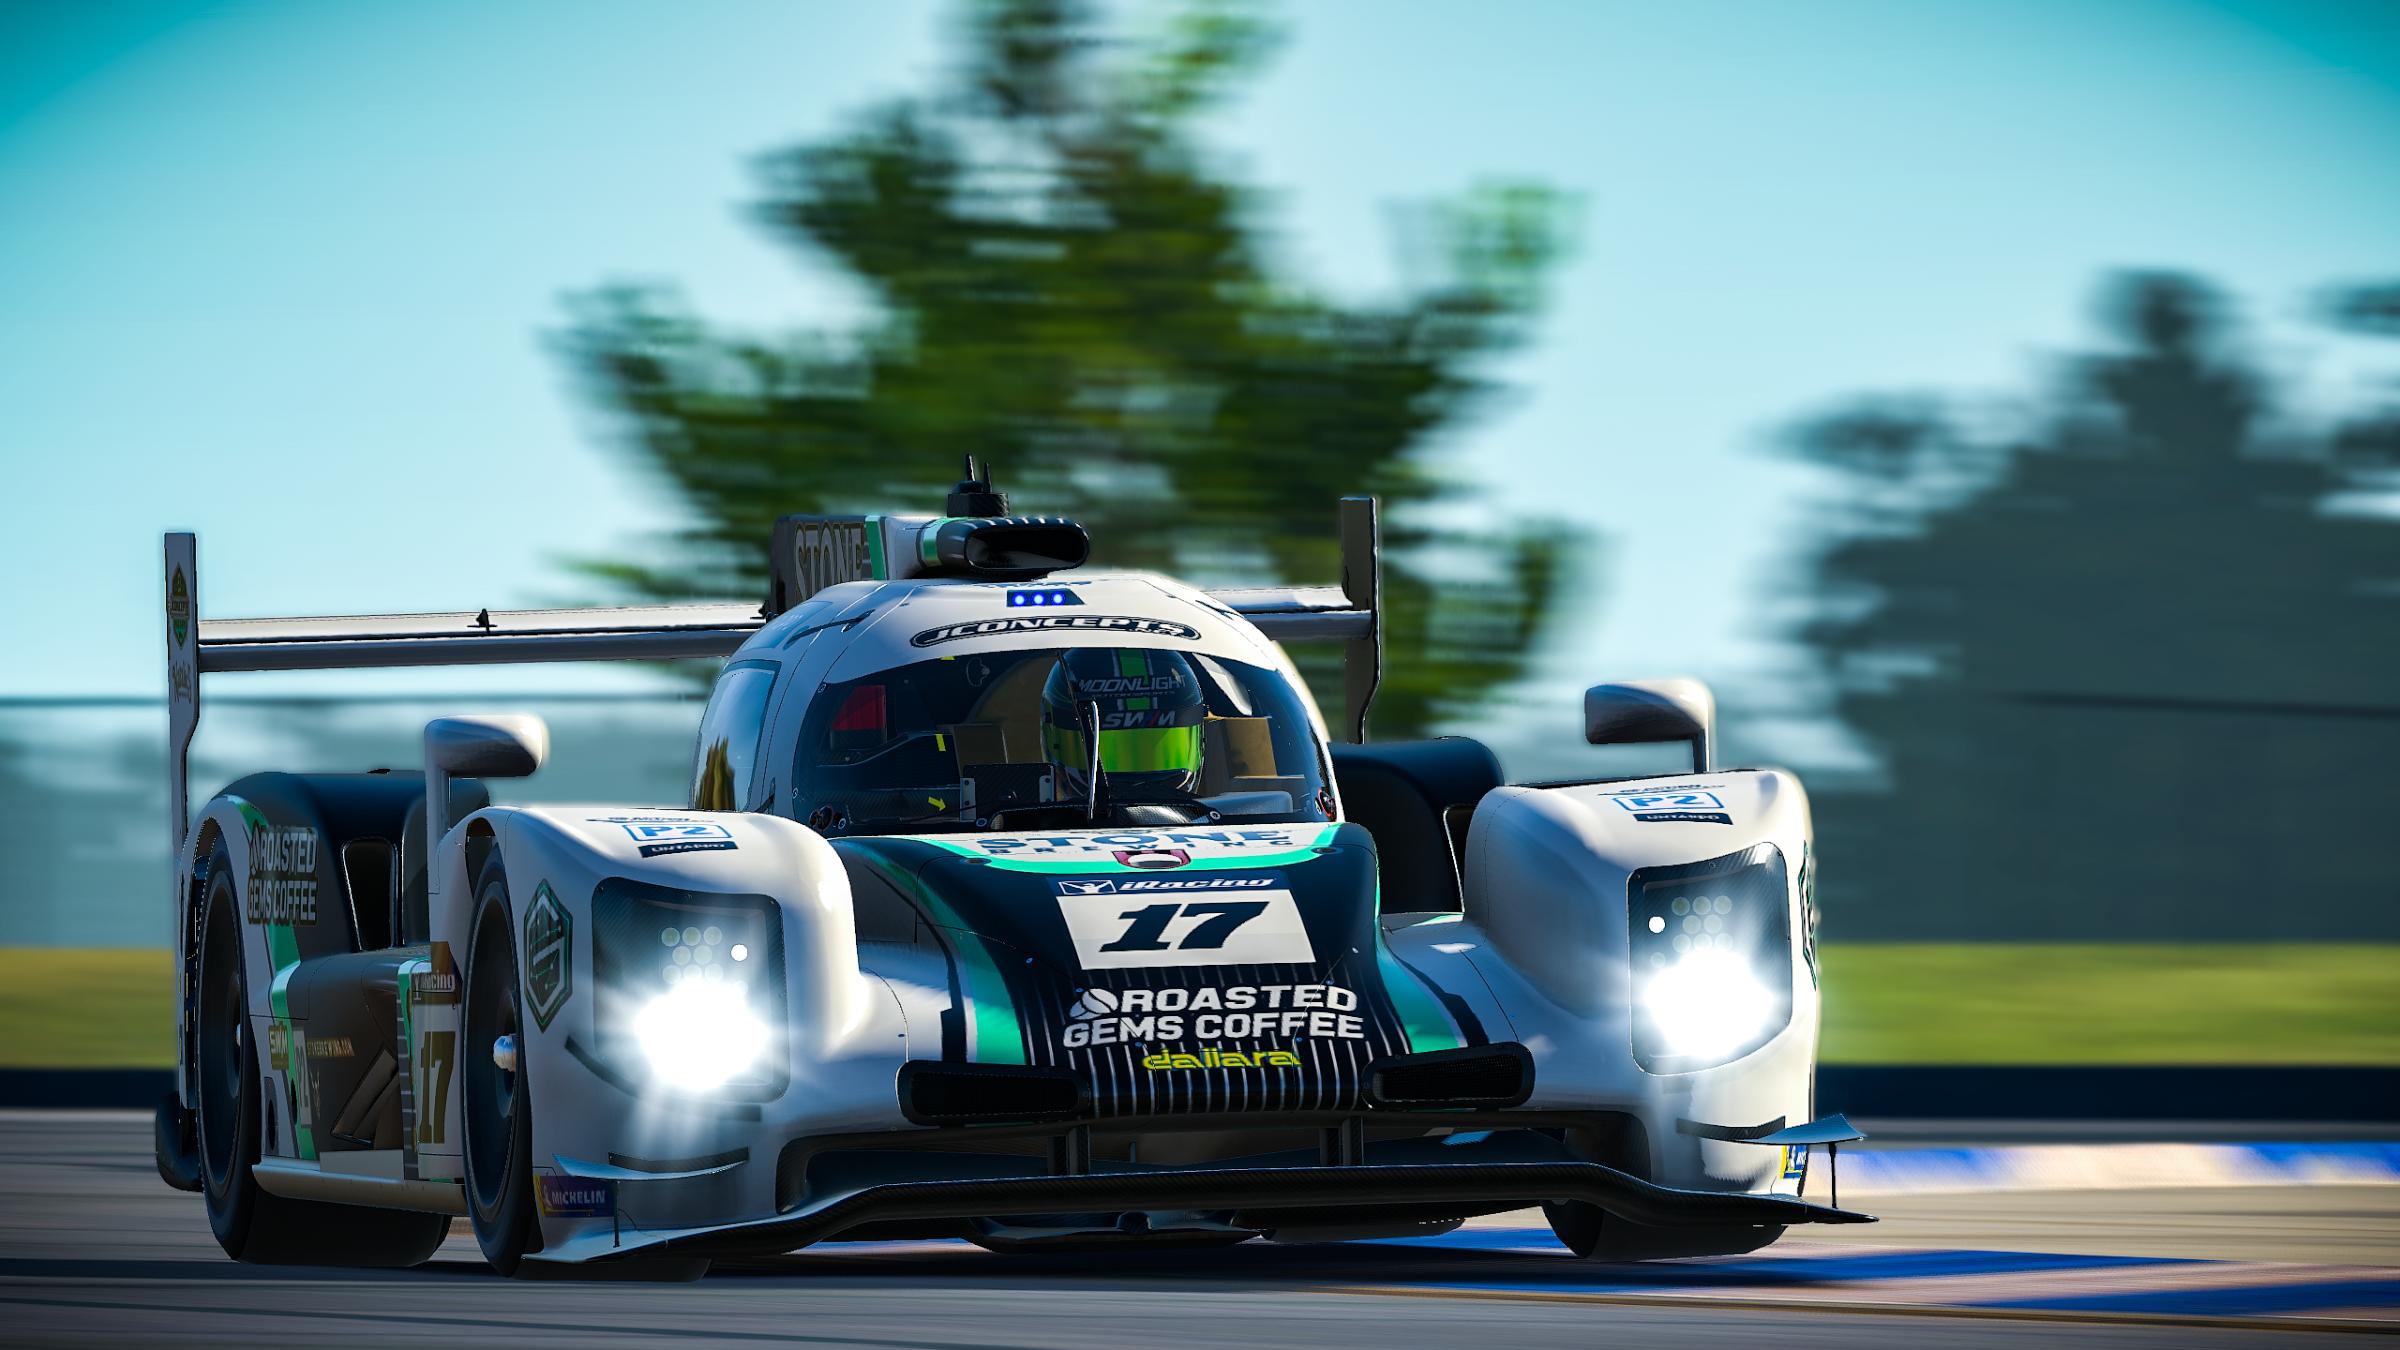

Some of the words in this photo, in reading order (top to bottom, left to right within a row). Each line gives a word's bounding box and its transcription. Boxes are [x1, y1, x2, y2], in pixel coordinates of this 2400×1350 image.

[922, 616, 1185, 643] JCONCEPTS
[1078, 674, 1186, 693] MOONLIGHT
[1629, 795, 1706, 807] P2
[638, 826, 714, 837] P2
[976, 830, 1290, 848] STONE
[260, 831, 317, 873] ROASTED
[988, 838, 1294, 855] BREWING
[1122, 877, 1275, 892] iRacing
[248, 878, 272, 920] GEMS
[272, 880, 317, 921] COFFEE
[1099, 901, 1270, 953] 17
[1119, 984, 1358, 1013] ROASTED
[1063, 1014, 1185, 1048] GEMS
[1195, 1011, 1365, 1040] COFFEE
[1142, 1047, 1303, 1071] dallara
[419, 1030, 456, 1144] 17
[551, 1190, 606, 1205] MICHELIN
